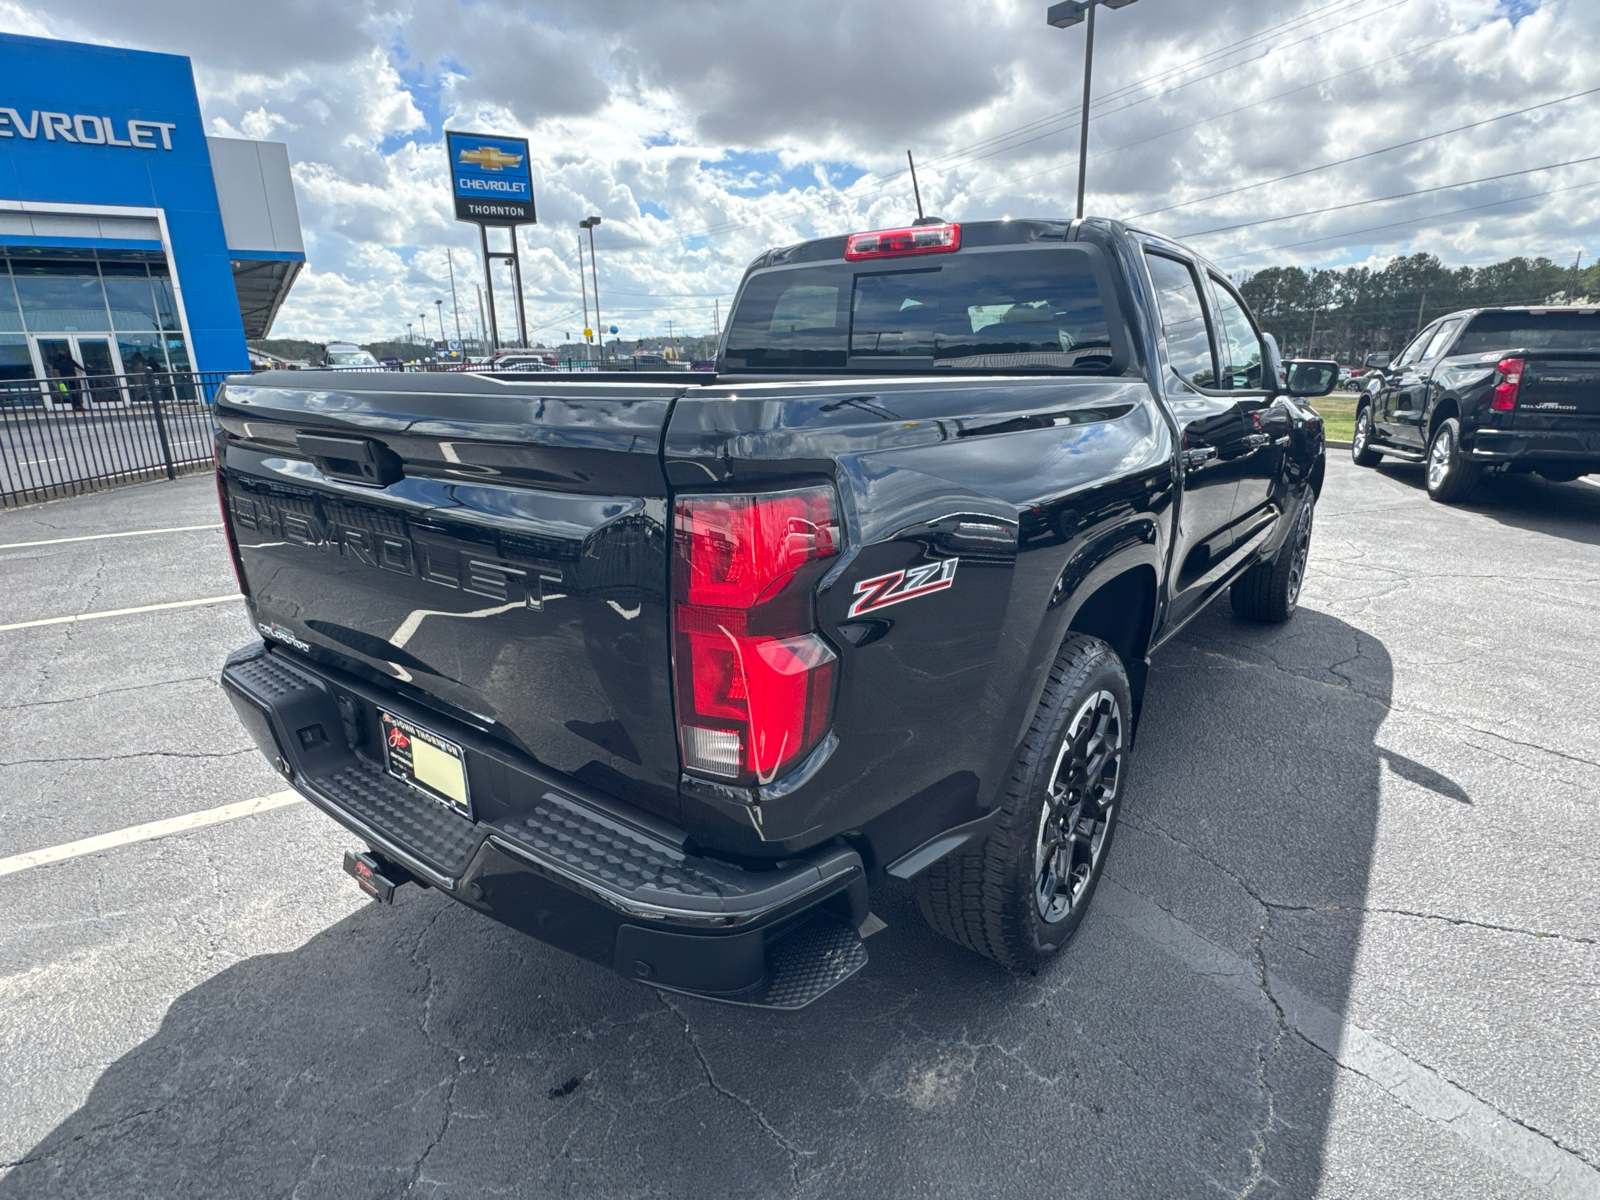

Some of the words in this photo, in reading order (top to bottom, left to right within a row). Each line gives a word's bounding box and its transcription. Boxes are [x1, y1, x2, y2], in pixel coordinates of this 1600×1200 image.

[459, 178, 526, 193] CHEVROLET
[468, 204, 525, 217] THORNTON
[233, 494, 564, 612] CHEVROLET
[846, 556, 960, 619] Z71
